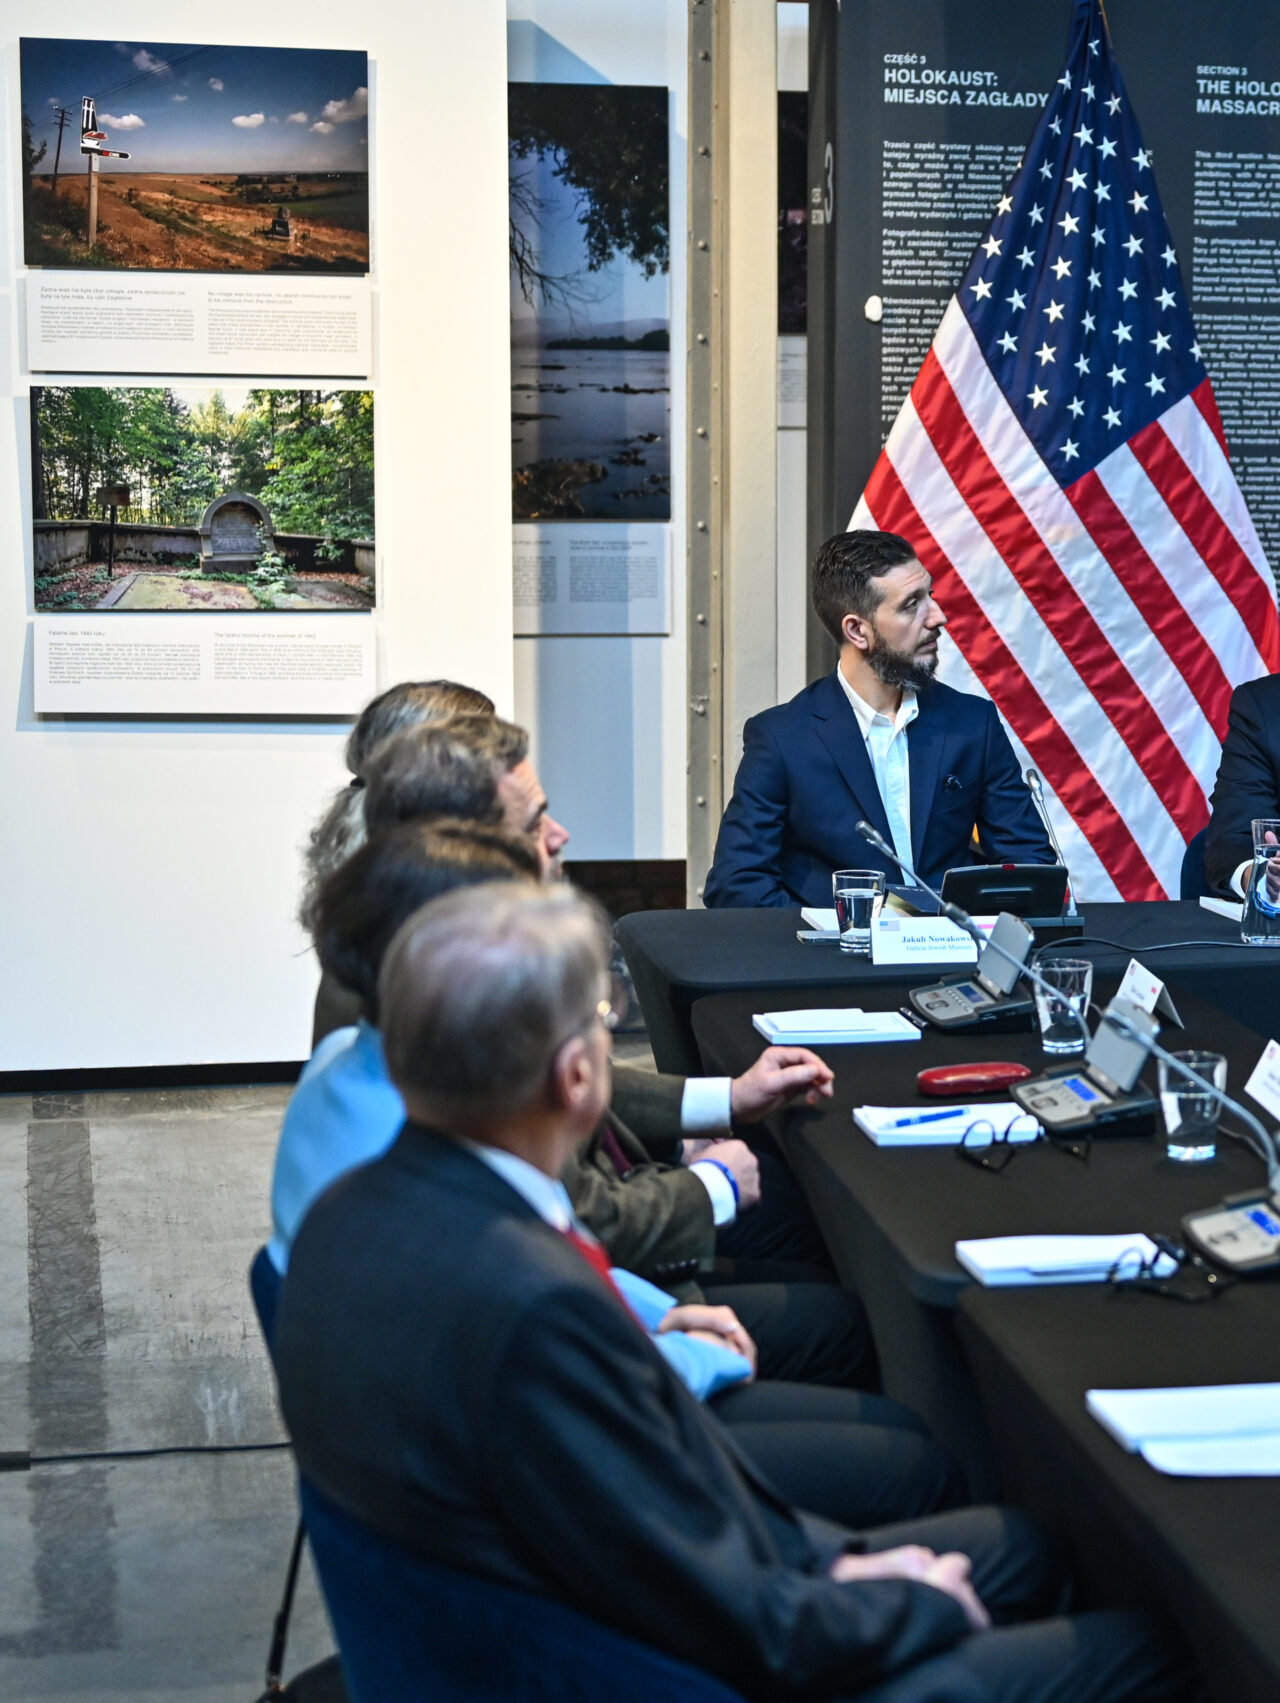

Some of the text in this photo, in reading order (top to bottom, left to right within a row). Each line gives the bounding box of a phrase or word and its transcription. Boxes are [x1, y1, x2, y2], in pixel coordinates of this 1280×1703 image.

[884, 54, 926, 65] CZĘŚĆ 3
[884, 68, 998, 86] HOLOKAUST:
[1196, 66, 1248, 76] SECTION 3
[1196, 80, 1230, 94] THE
[884, 88, 1048, 108] MIEJSCA ZAGŁADY
